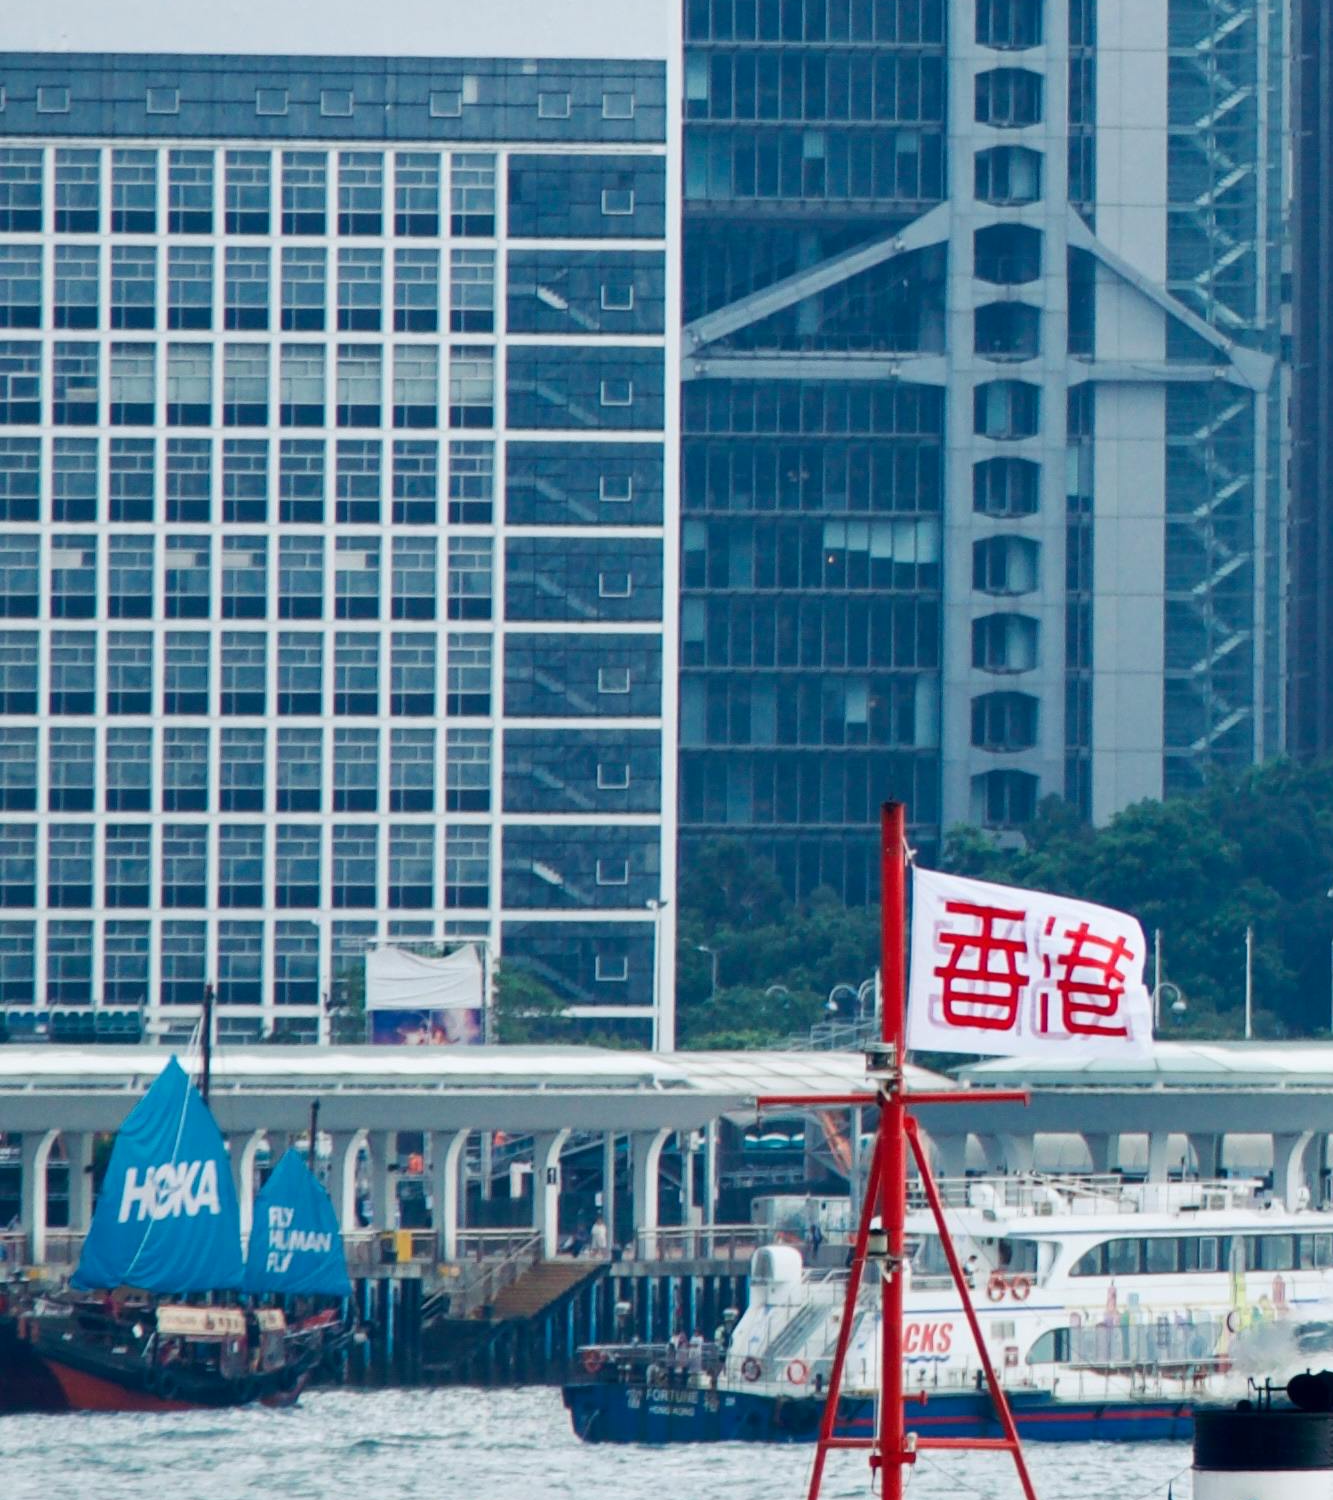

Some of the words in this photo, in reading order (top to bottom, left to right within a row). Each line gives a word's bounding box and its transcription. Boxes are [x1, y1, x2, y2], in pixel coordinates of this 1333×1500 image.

[933, 901, 1135, 1037] 香港
[117, 1159, 222, 1224] HOKA
[268, 1205, 295, 1229] FLY
[268, 1230, 332, 1253] HUMAN
[265, 1252, 293, 1273] FLY
[901, 1322, 953, 1354] CKS
